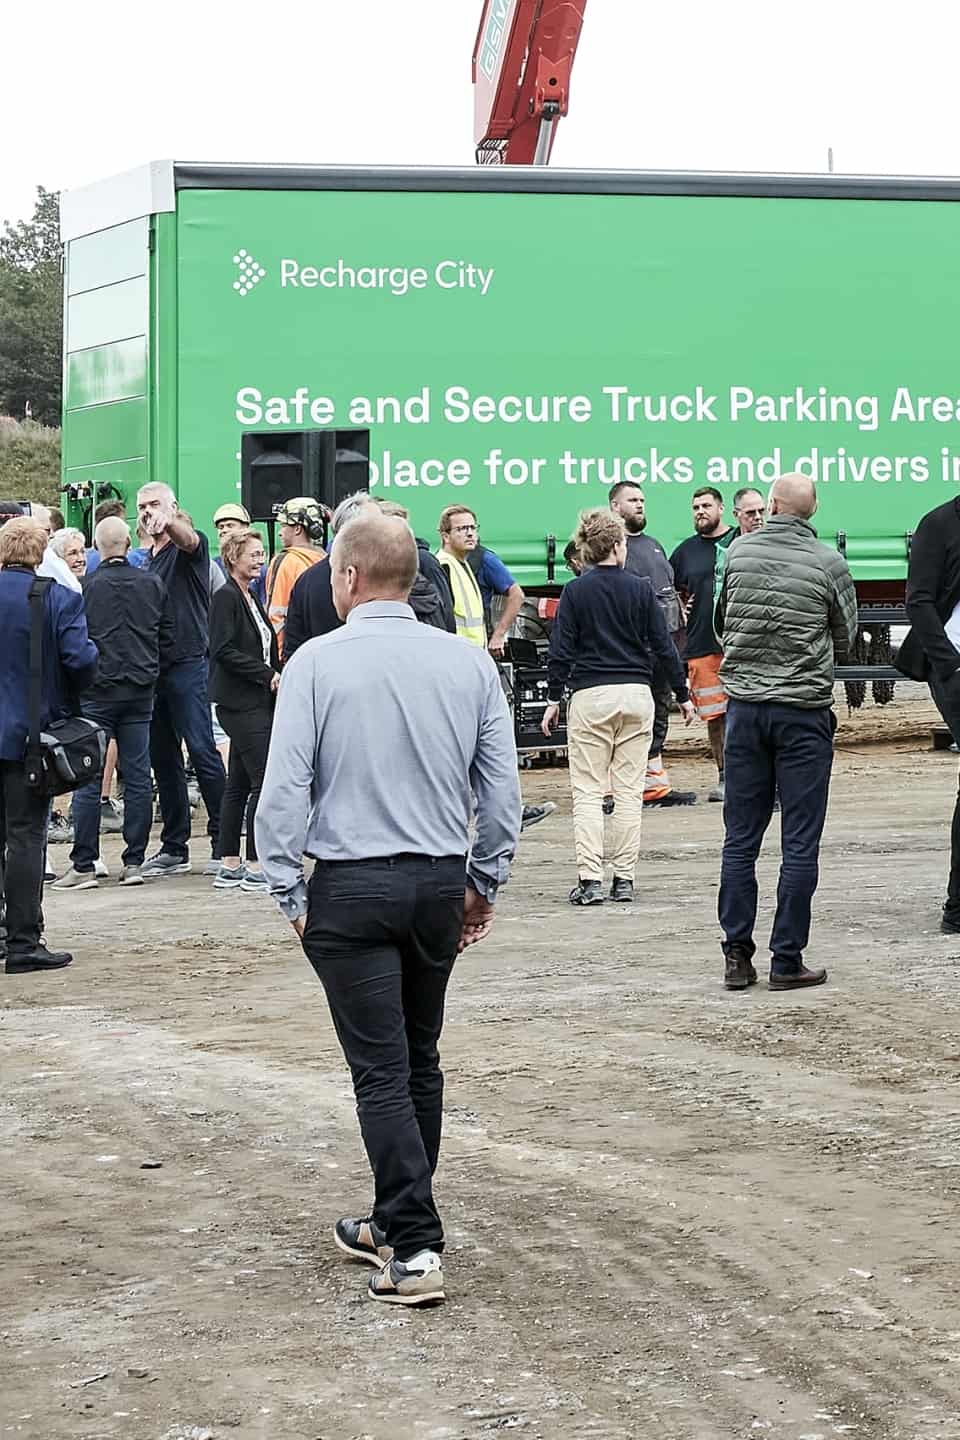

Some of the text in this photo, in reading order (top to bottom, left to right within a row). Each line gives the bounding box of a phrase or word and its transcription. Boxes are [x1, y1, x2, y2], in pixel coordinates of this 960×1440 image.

[280, 259, 494, 295] Recharge City
[235, 387, 335, 425] Safe
[349, 387, 430, 424] and
[444, 386, 592, 424] Secure
[602, 386, 718, 423] Truck
[729, 386, 879, 431] Parking
[484, 449, 546, 486] for
[557, 447, 694, 484] trucks
[706, 447, 781, 483] and
[794, 447, 929, 483] drivers
